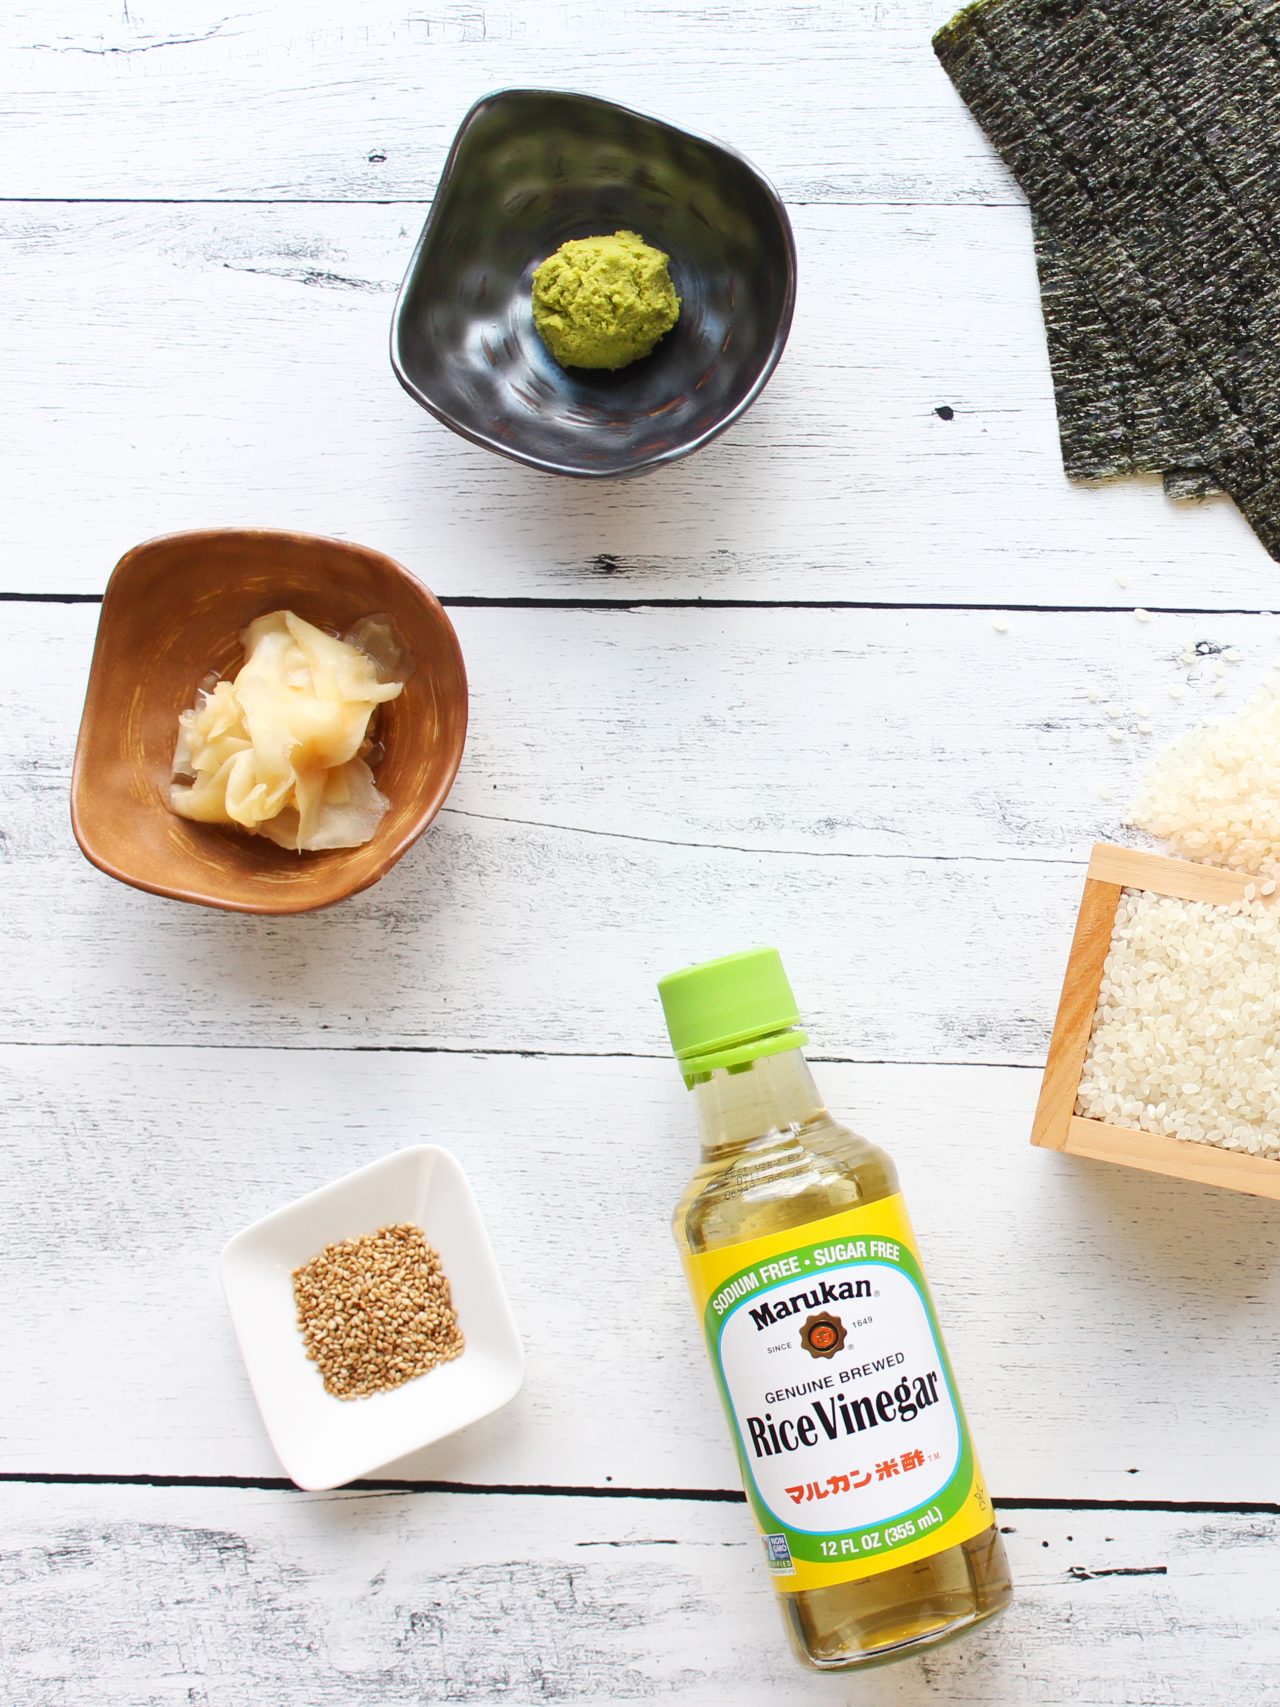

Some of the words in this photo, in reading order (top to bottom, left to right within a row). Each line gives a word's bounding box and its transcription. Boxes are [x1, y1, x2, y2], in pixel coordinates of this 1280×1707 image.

[713, 1272, 760, 1315] SODIUM
[761, 1256, 801, 1284] FREE
[813, 1241, 867, 1267] SUGAR
[870, 1241, 900, 1262] FREE
[748, 1280, 872, 1332] Marukan
[767, 1342, 792, 1354] SINCE
[852, 1316, 873, 1329] 1649
[765, 1376, 835, 1404] GENUINE
[838, 1352, 905, 1384] BREWED
[746, 1413, 818, 1458] Rice
[811, 1370, 939, 1440] Vinegar
[770, 1536, 785, 1545] NON
[773, 1545, 787, 1553] GMO
[820, 1541, 838, 1556] 12
[841, 1538, 859, 1555] FL
[861, 1531, 882, 1550] OZ
[885, 1520, 916, 1546] (355
[918, 1505, 944, 1530] mL)
